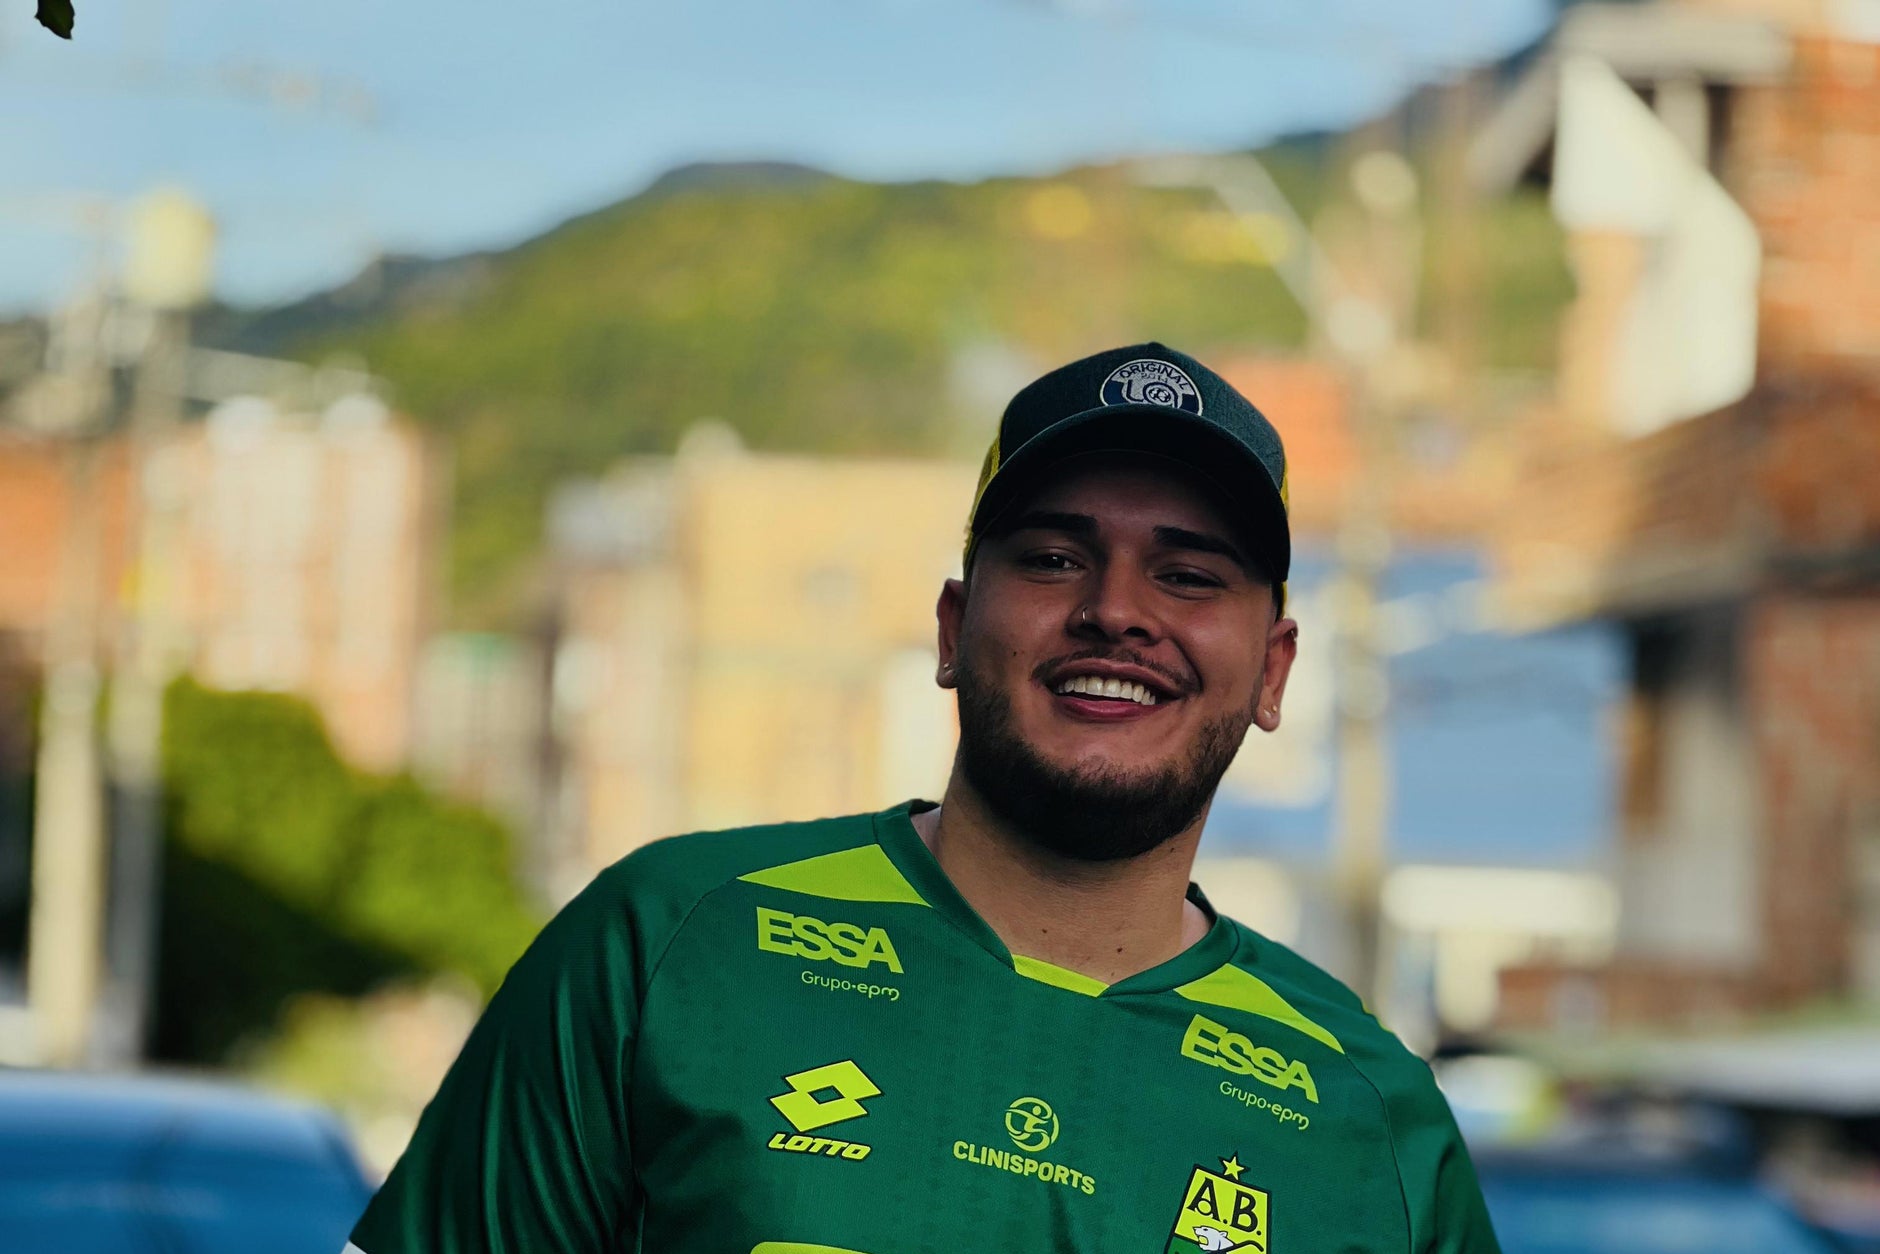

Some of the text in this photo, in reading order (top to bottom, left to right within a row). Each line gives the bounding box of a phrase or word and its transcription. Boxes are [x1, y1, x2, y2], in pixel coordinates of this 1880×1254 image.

[1119, 362, 1188, 390] ORIGINAL
[756, 906, 904, 975] ESSA
[1181, 1013, 1319, 1104] ESSA
[768, 1133, 872, 1160] LOTTO
[953, 1140, 1096, 1195] CLINISPORTS
